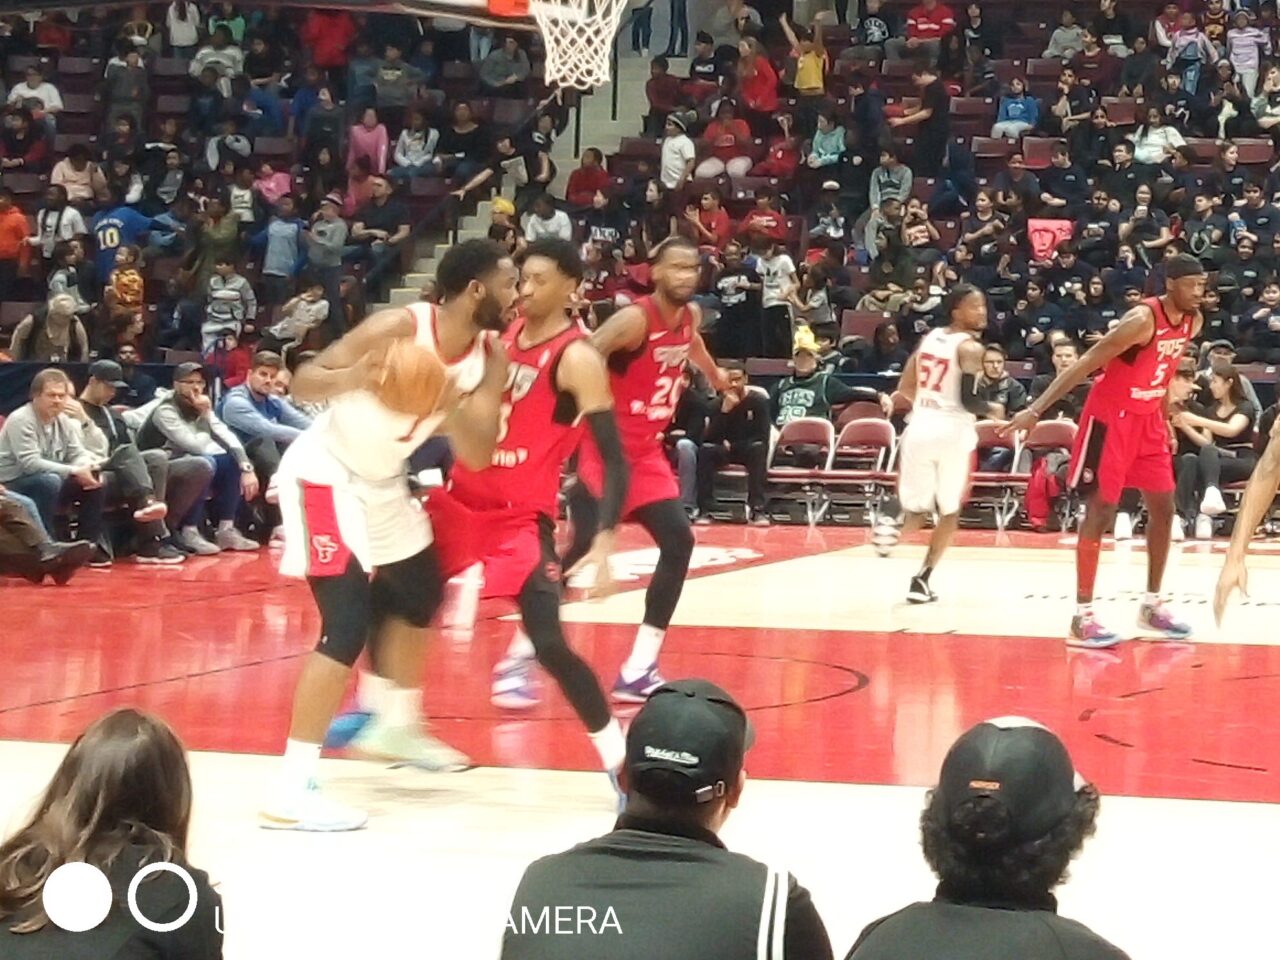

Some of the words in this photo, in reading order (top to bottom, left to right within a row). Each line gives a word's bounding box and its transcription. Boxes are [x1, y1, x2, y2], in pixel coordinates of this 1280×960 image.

[97, 227, 120, 251] 10
[919, 351, 951, 393] 57
[1149, 363, 1169, 387] 5
